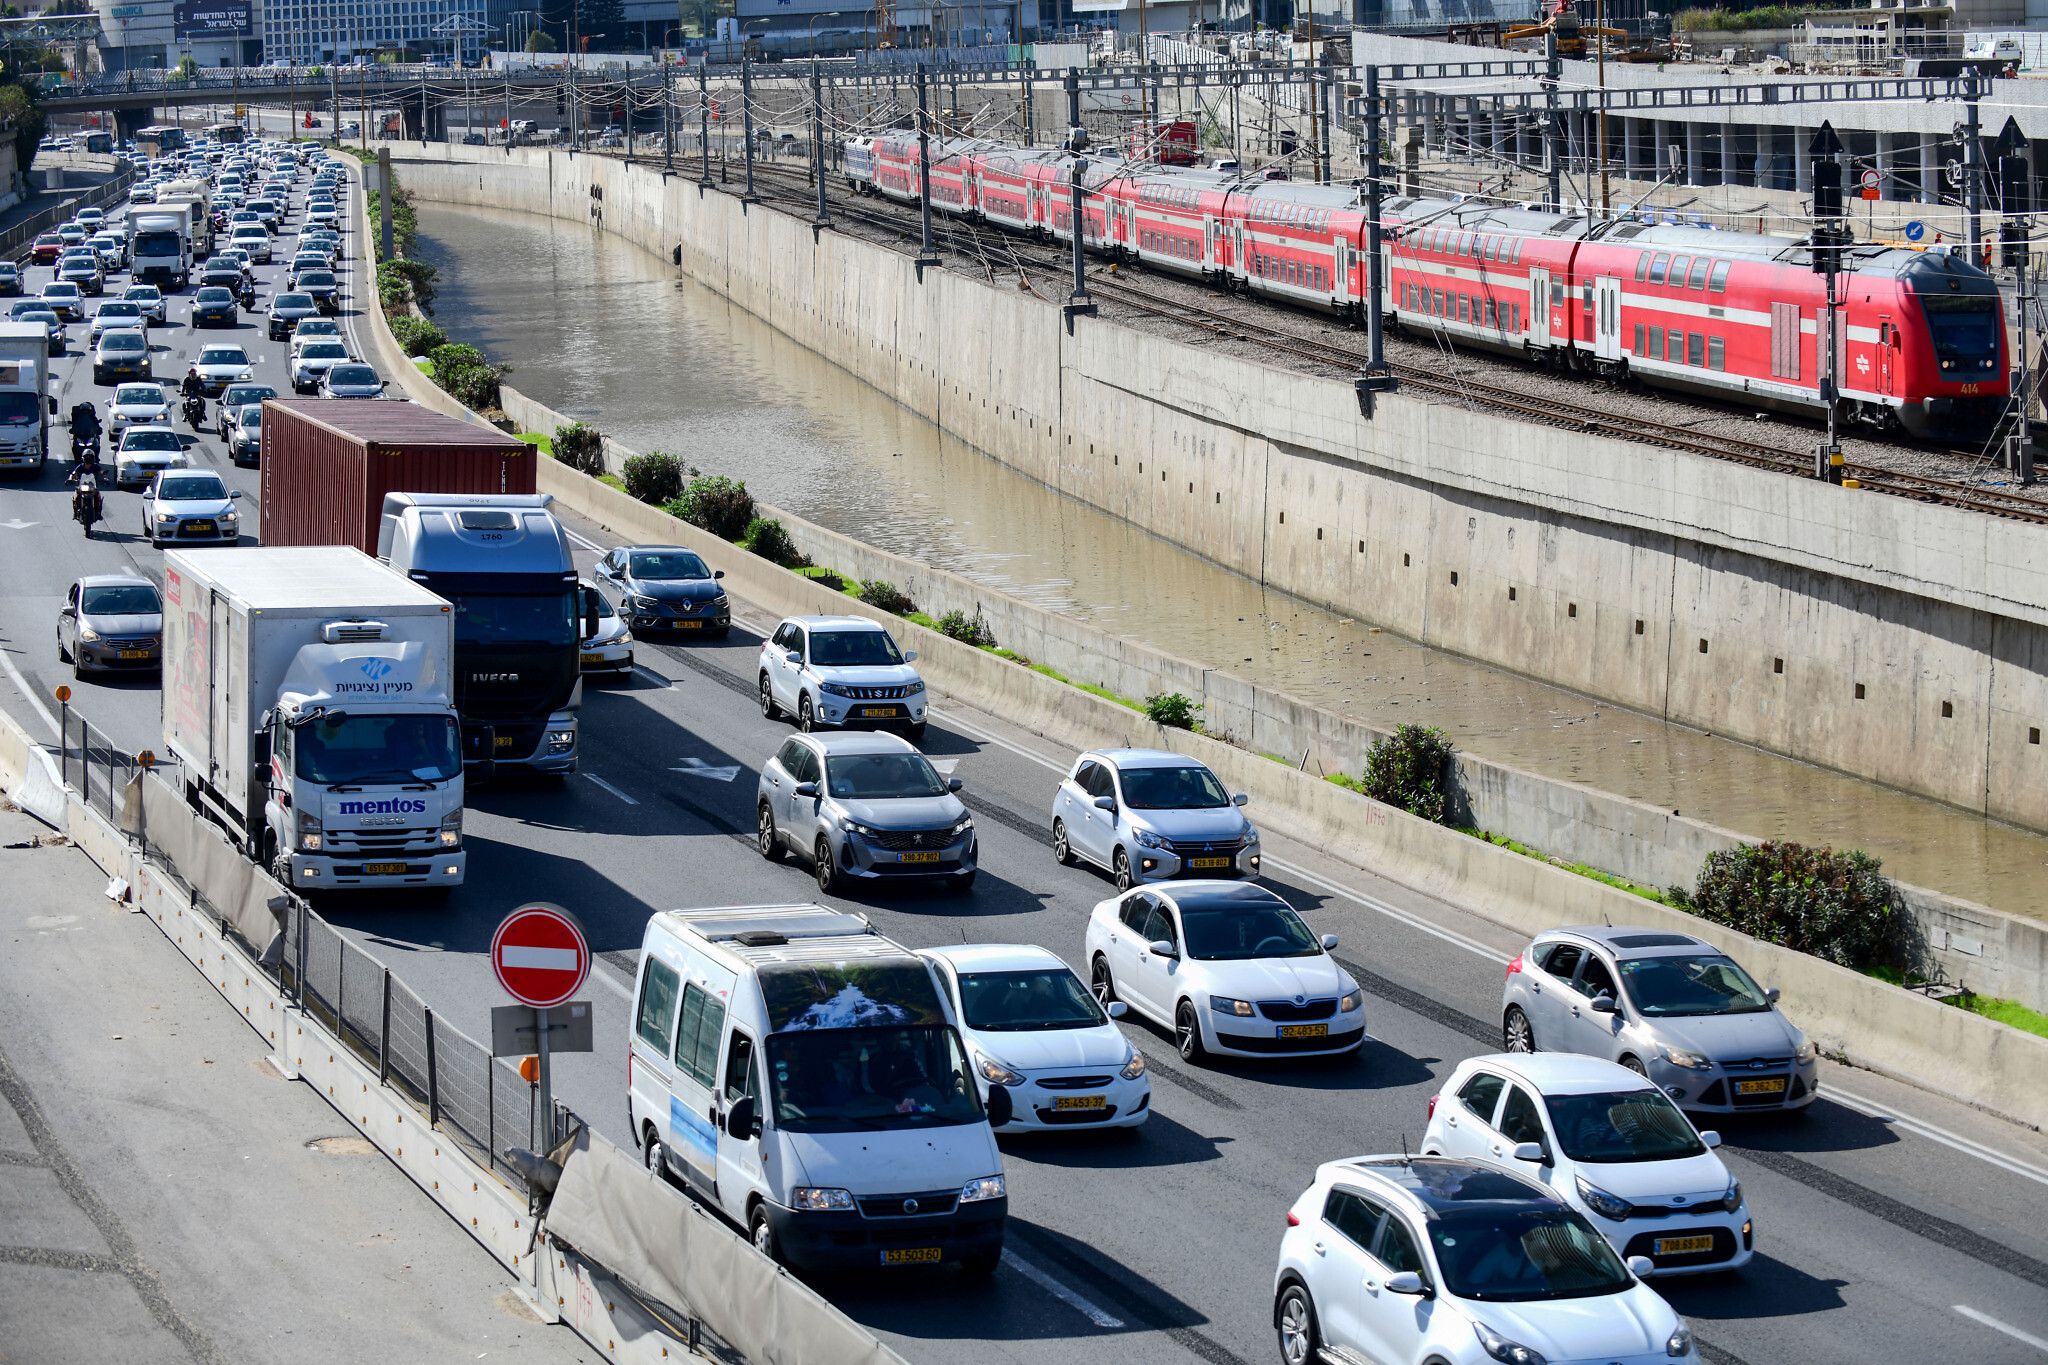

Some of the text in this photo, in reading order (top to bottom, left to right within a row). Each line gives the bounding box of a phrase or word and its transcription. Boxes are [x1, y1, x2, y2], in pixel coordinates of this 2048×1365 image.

[193, 10, 247, 20] ערוץ החדשות
[1960, 383, 1979, 394] 414
[472, 673, 519, 683] IVECO
[383, 682, 413, 694] מעיין
[339, 797, 426, 815] mentos
[360, 816, 405, 826] ISUZU
